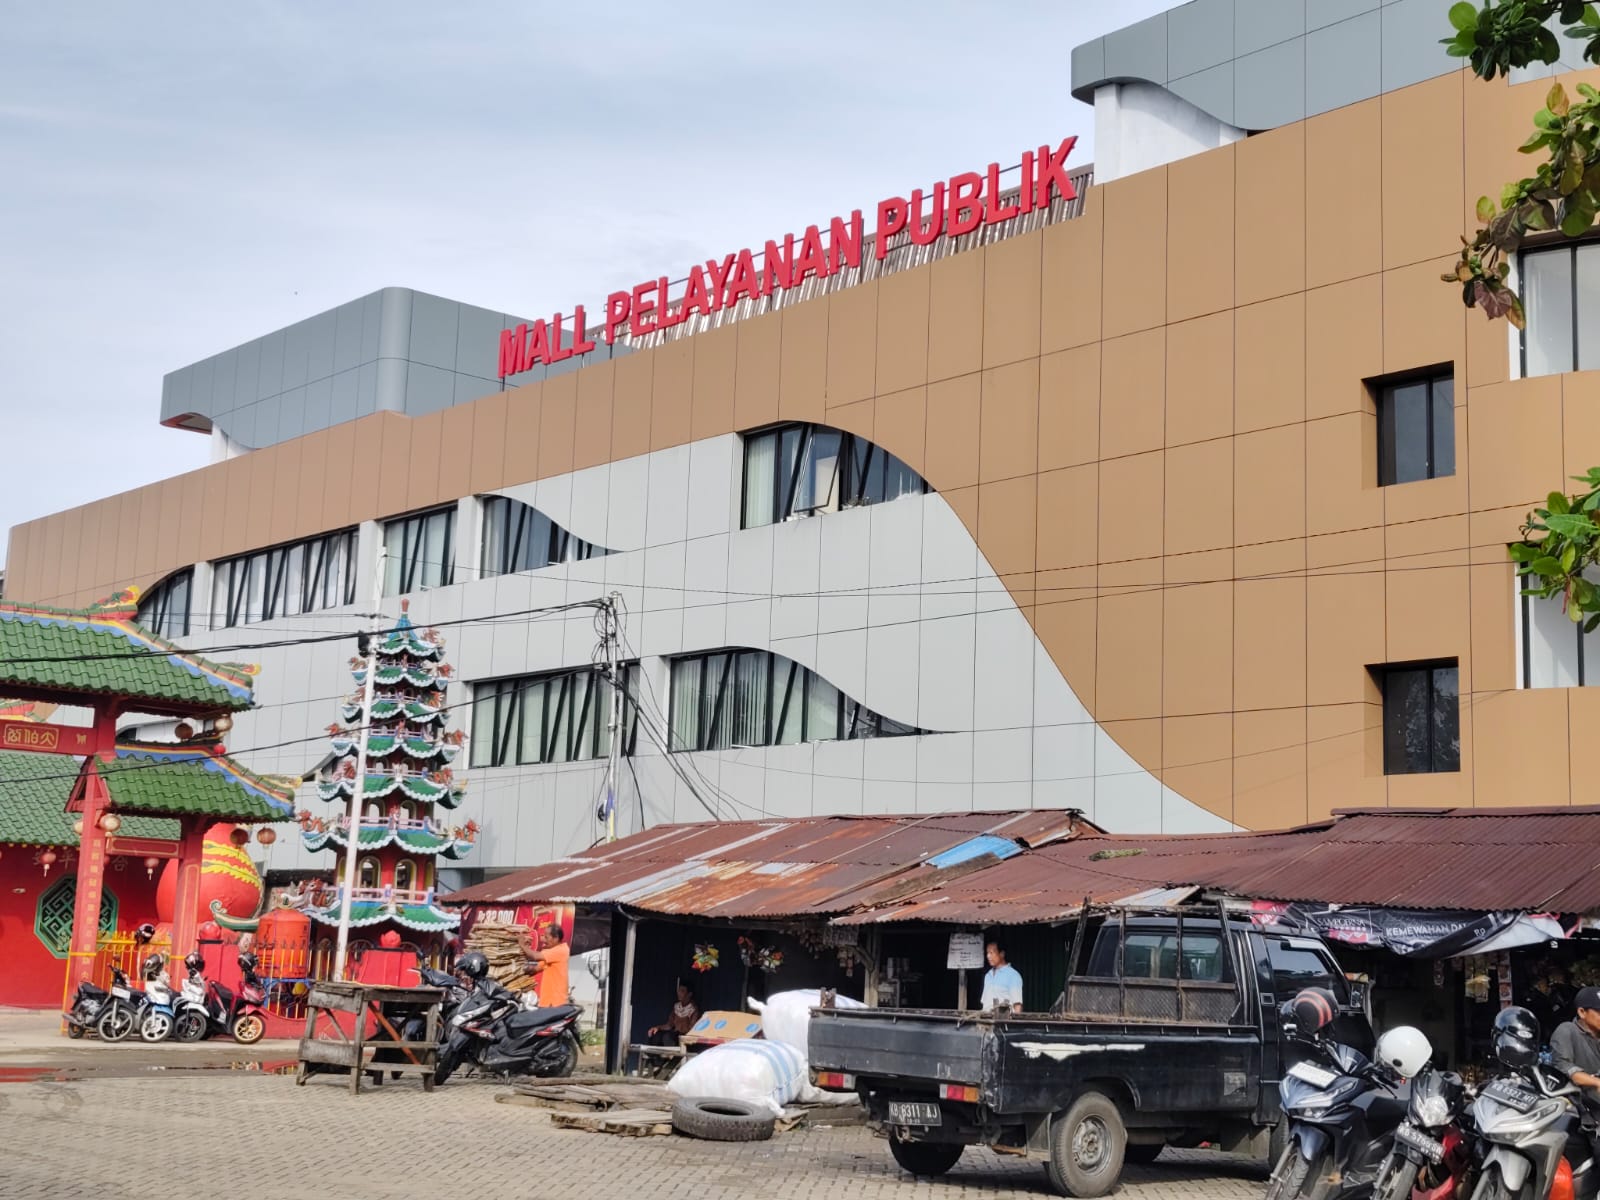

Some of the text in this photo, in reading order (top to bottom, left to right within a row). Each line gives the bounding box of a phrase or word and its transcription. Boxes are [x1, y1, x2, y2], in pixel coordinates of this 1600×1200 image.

[498, 135, 1079, 378] MALL PELAYANAN PUBLIK
[1385, 922, 1467, 937] KEMEWAHAN DA
